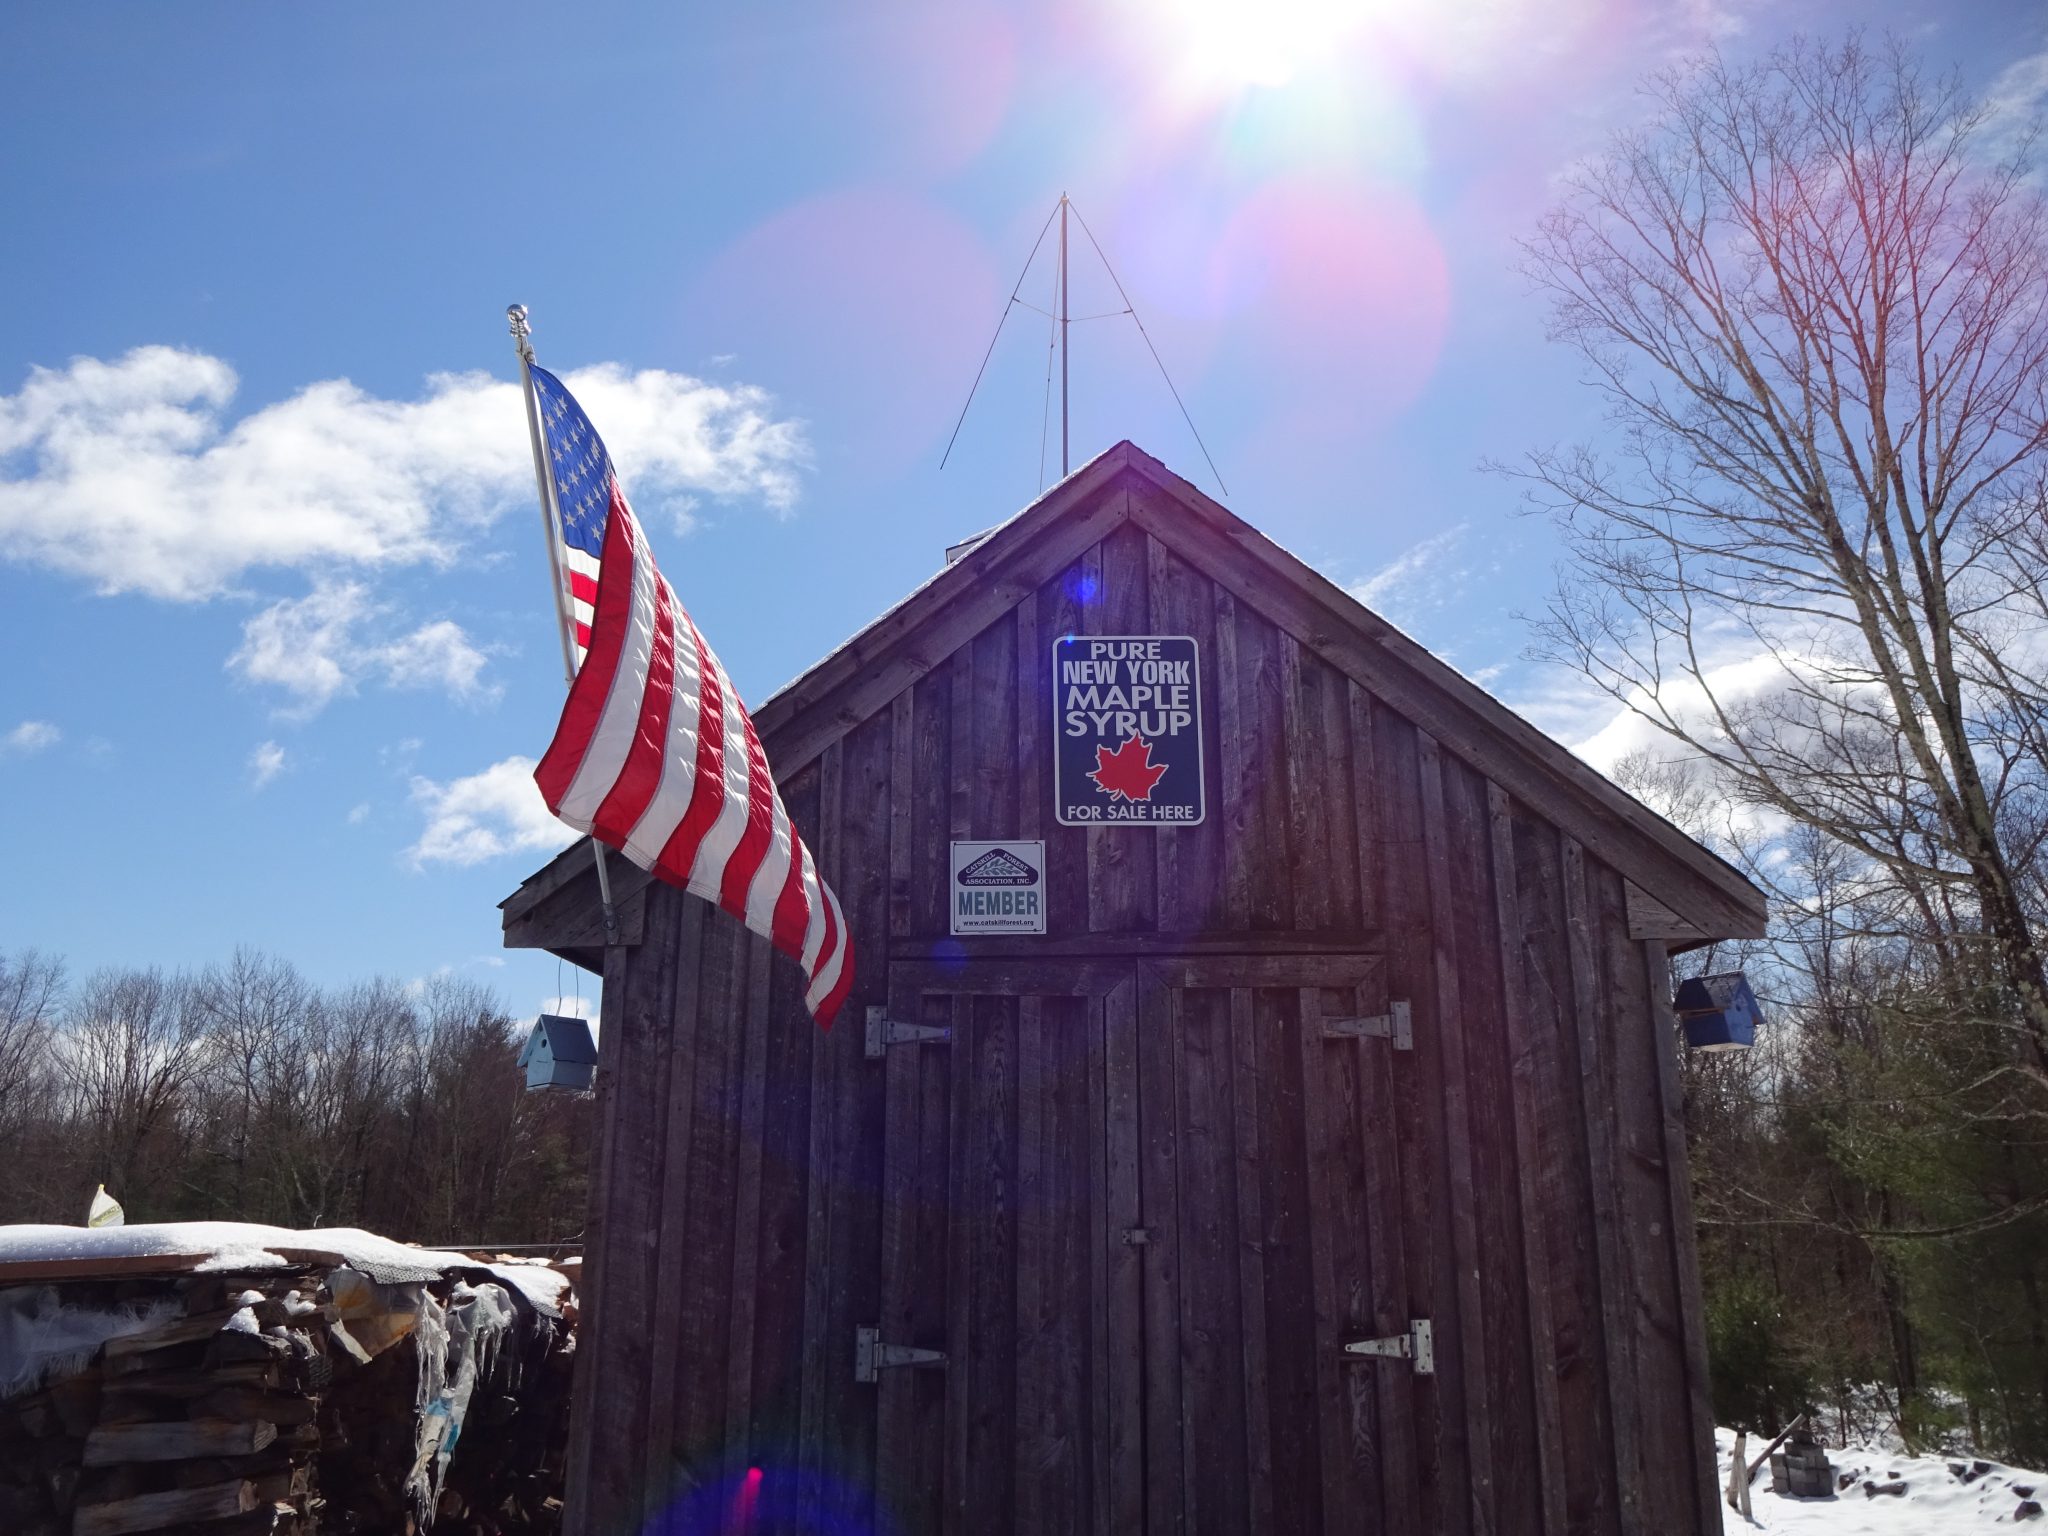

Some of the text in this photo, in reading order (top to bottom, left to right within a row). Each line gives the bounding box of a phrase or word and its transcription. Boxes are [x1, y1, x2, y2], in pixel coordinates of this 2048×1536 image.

[1091, 642, 1161, 660] PURE
[1063, 661, 1190, 685] NEW YORK
[1066, 685, 1189, 710] MAPLE
[1065, 711, 1192, 737] SYRUP
[1067, 806, 1193, 820] FOR SALE HERE
[965, 852, 1029, 874] CATSKILL FOREST
[959, 891, 1038, 916] MEMBER
